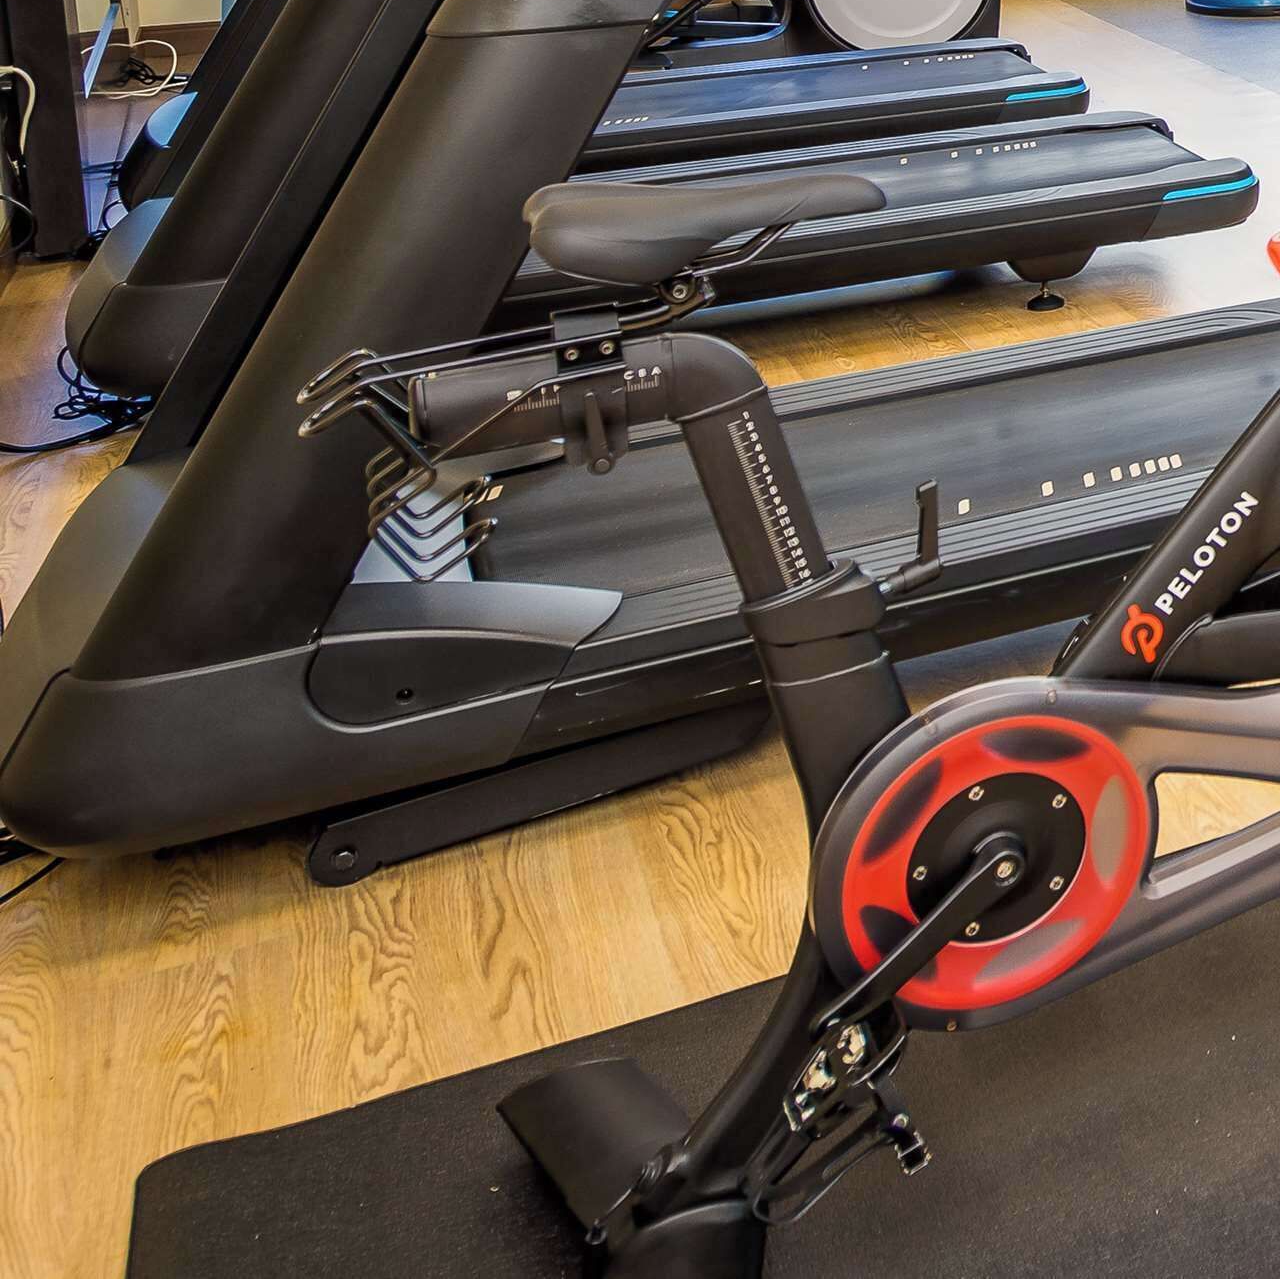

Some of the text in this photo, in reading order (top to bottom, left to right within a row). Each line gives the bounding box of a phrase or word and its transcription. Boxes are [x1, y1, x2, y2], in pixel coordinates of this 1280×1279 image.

[623, 371, 634, 380] C
[651, 366, 662, 375] A
[765, 475, 773, 484] 7
[1153, 491, 1259, 616] PELOTON
